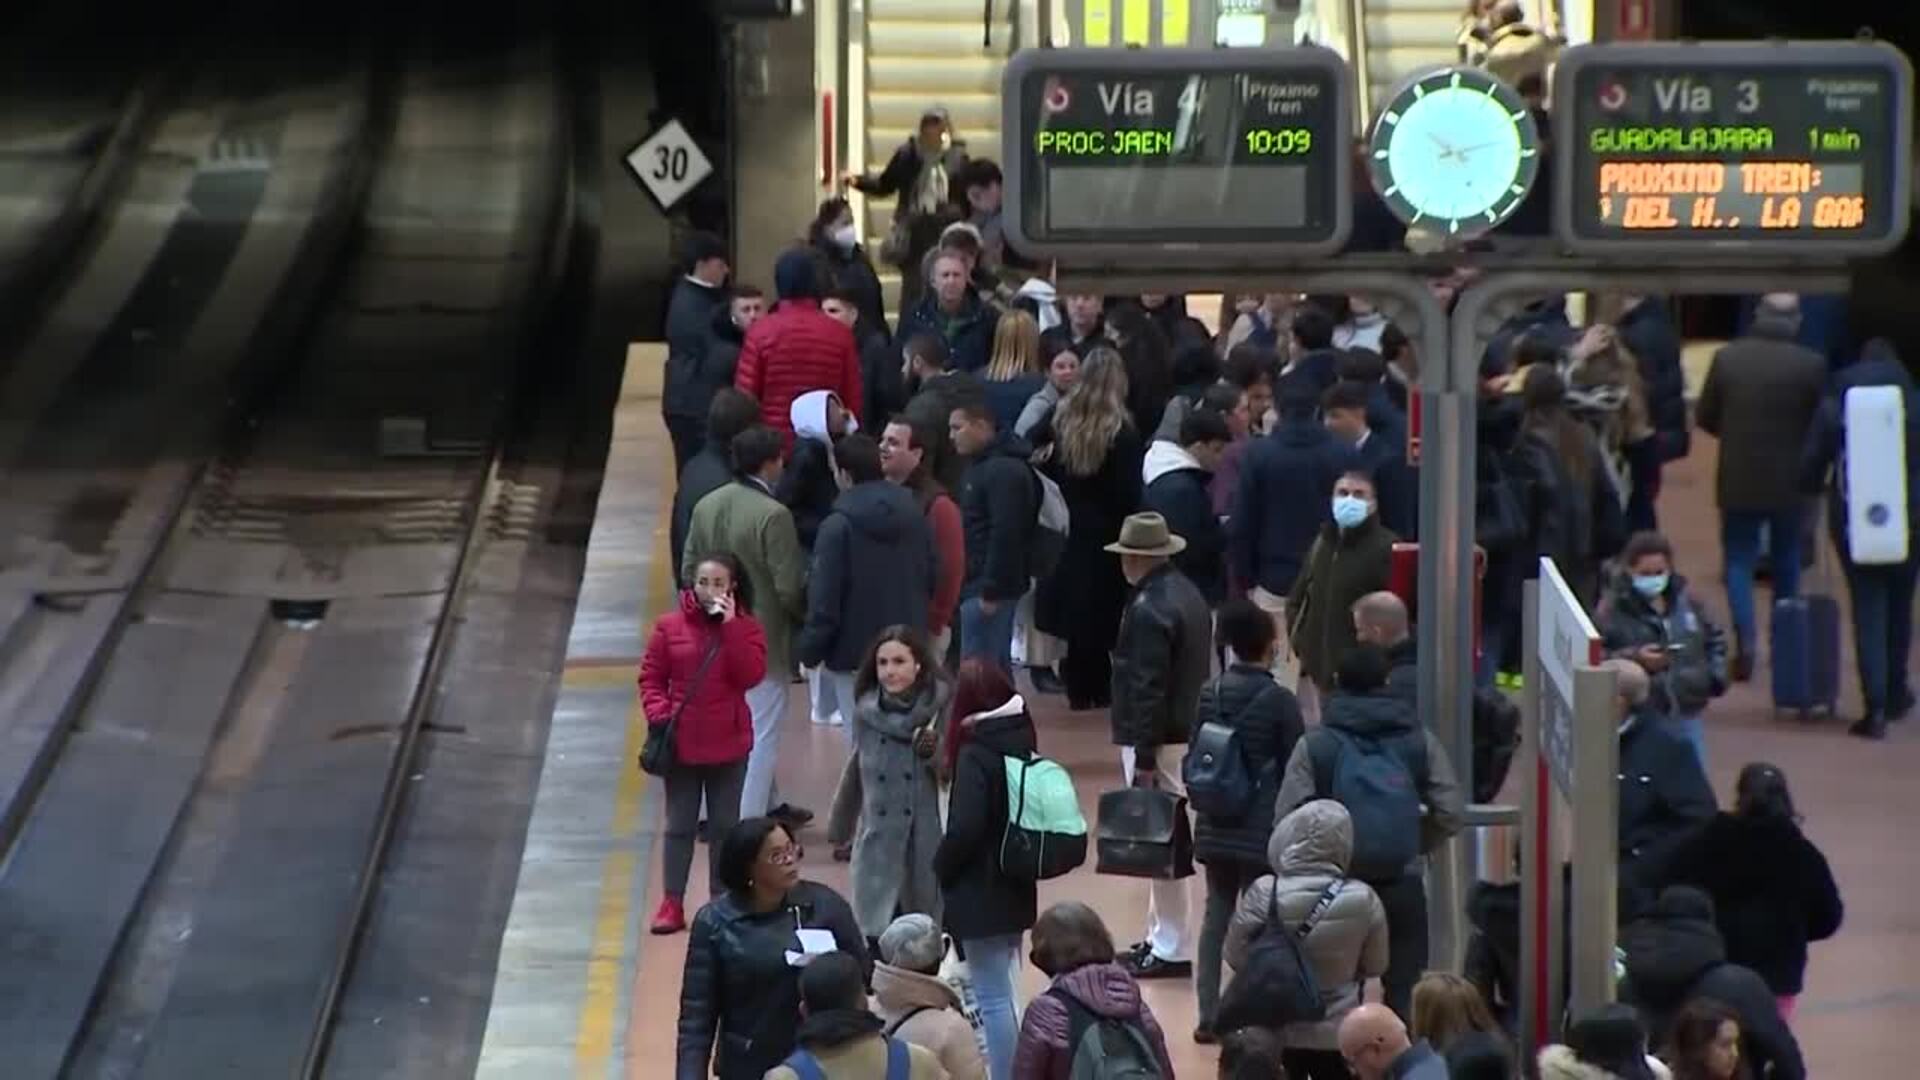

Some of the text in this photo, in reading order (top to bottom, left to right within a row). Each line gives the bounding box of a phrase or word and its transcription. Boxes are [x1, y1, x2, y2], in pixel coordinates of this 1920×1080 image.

[1098, 81, 1154, 115] Vía
[1654, 79, 1760, 113] Vía 3
[1038, 131, 1171, 154] PROC JAEN
[1246, 130, 1311, 154] 10:09
[1590, 128, 1773, 151] GUADALAJARA
[1809, 127, 1860, 150] 1 min
[653, 145, 688, 181] 30
[1600, 162, 1822, 193] PROXIMO TREN:
[1623, 196, 1678, 228] DEL
[1761, 196, 1801, 228] LA
